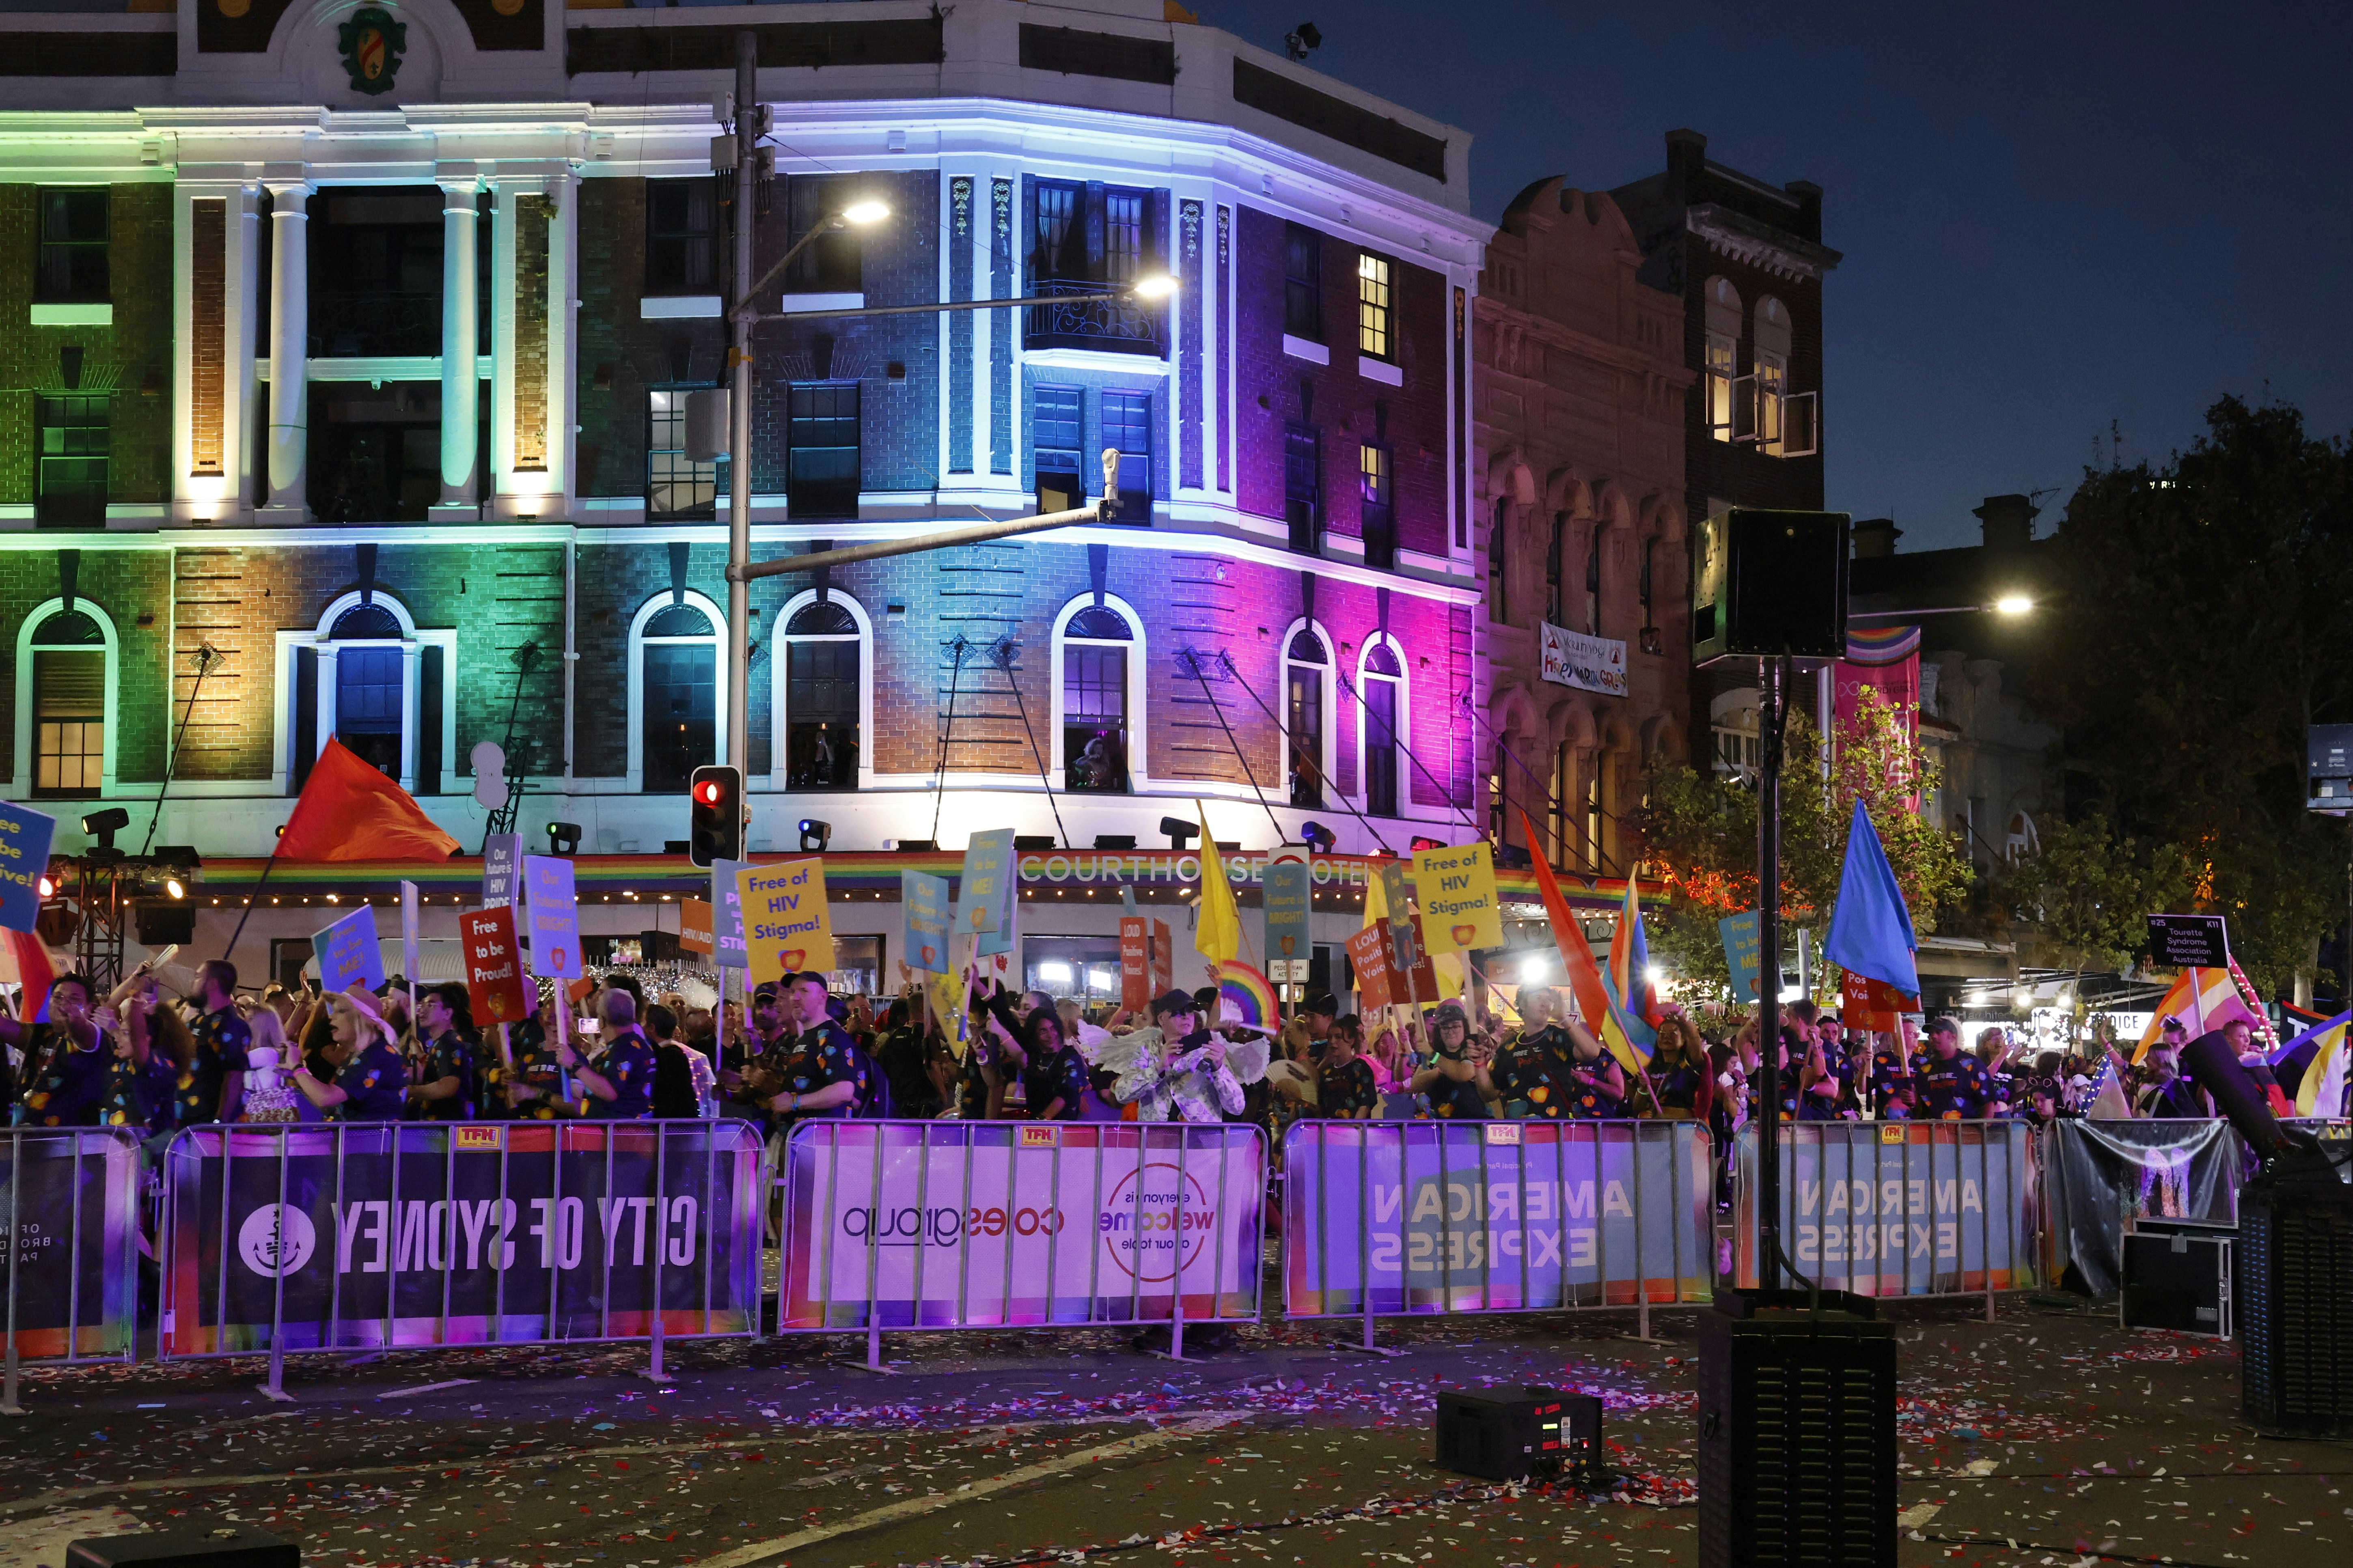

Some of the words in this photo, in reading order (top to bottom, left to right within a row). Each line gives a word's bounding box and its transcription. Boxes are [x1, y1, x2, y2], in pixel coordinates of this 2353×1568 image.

[1876, 686, 1891, 694] RDI
[0, 819, 20, 833] ee
[494, 849, 507, 861] Our
[1423, 858, 1458, 872] Free
[1462, 851, 1477, 866] of
[0, 863, 34, 887] ive!
[1018, 855, 1263, 882] COURTHOSE
[1311, 859, 1370, 887] OTEL
[490, 878, 507, 894] HIV
[748, 877, 787, 892] Free
[791, 868, 808, 885] of
[1275, 874, 1294, 887] Our
[1441, 874, 1469, 892] HIV
[768, 894, 800, 913] HIV
[1429, 893, 1489, 916] Stigma!
[1268, 910, 1305, 924] BRIGHT!
[472, 920, 498, 935] Free
[754, 915, 821, 940] Stigma!
[1123, 924, 1141, 938] LOUD
[1730, 920, 1753, 933] Free
[2168, 928, 2203, 937] Tourette
[1355, 928, 1380, 951] LOU
[1736, 940, 1746, 950] to
[2167, 937, 2207, 946] Syndrome
[475, 946, 488, 958] to
[489, 941, 505, 956] be
[1357, 945, 1383, 968] Positi
[2166, 946, 2212, 955] Association
[338, 951, 364, 978] ME!
[2172, 955, 2208, 964] Australia
[474, 961, 513, 983] Proud!
[1362, 963, 1386, 980] Voic
[1848, 973, 1866, 984] Pos
[1850, 988, 1869, 1000] Voi
[462, 1129, 494, 1141] TFH
[1026, 1129, 1050, 1140] TFH
[1885, 1127, 1900, 1137] TFH
